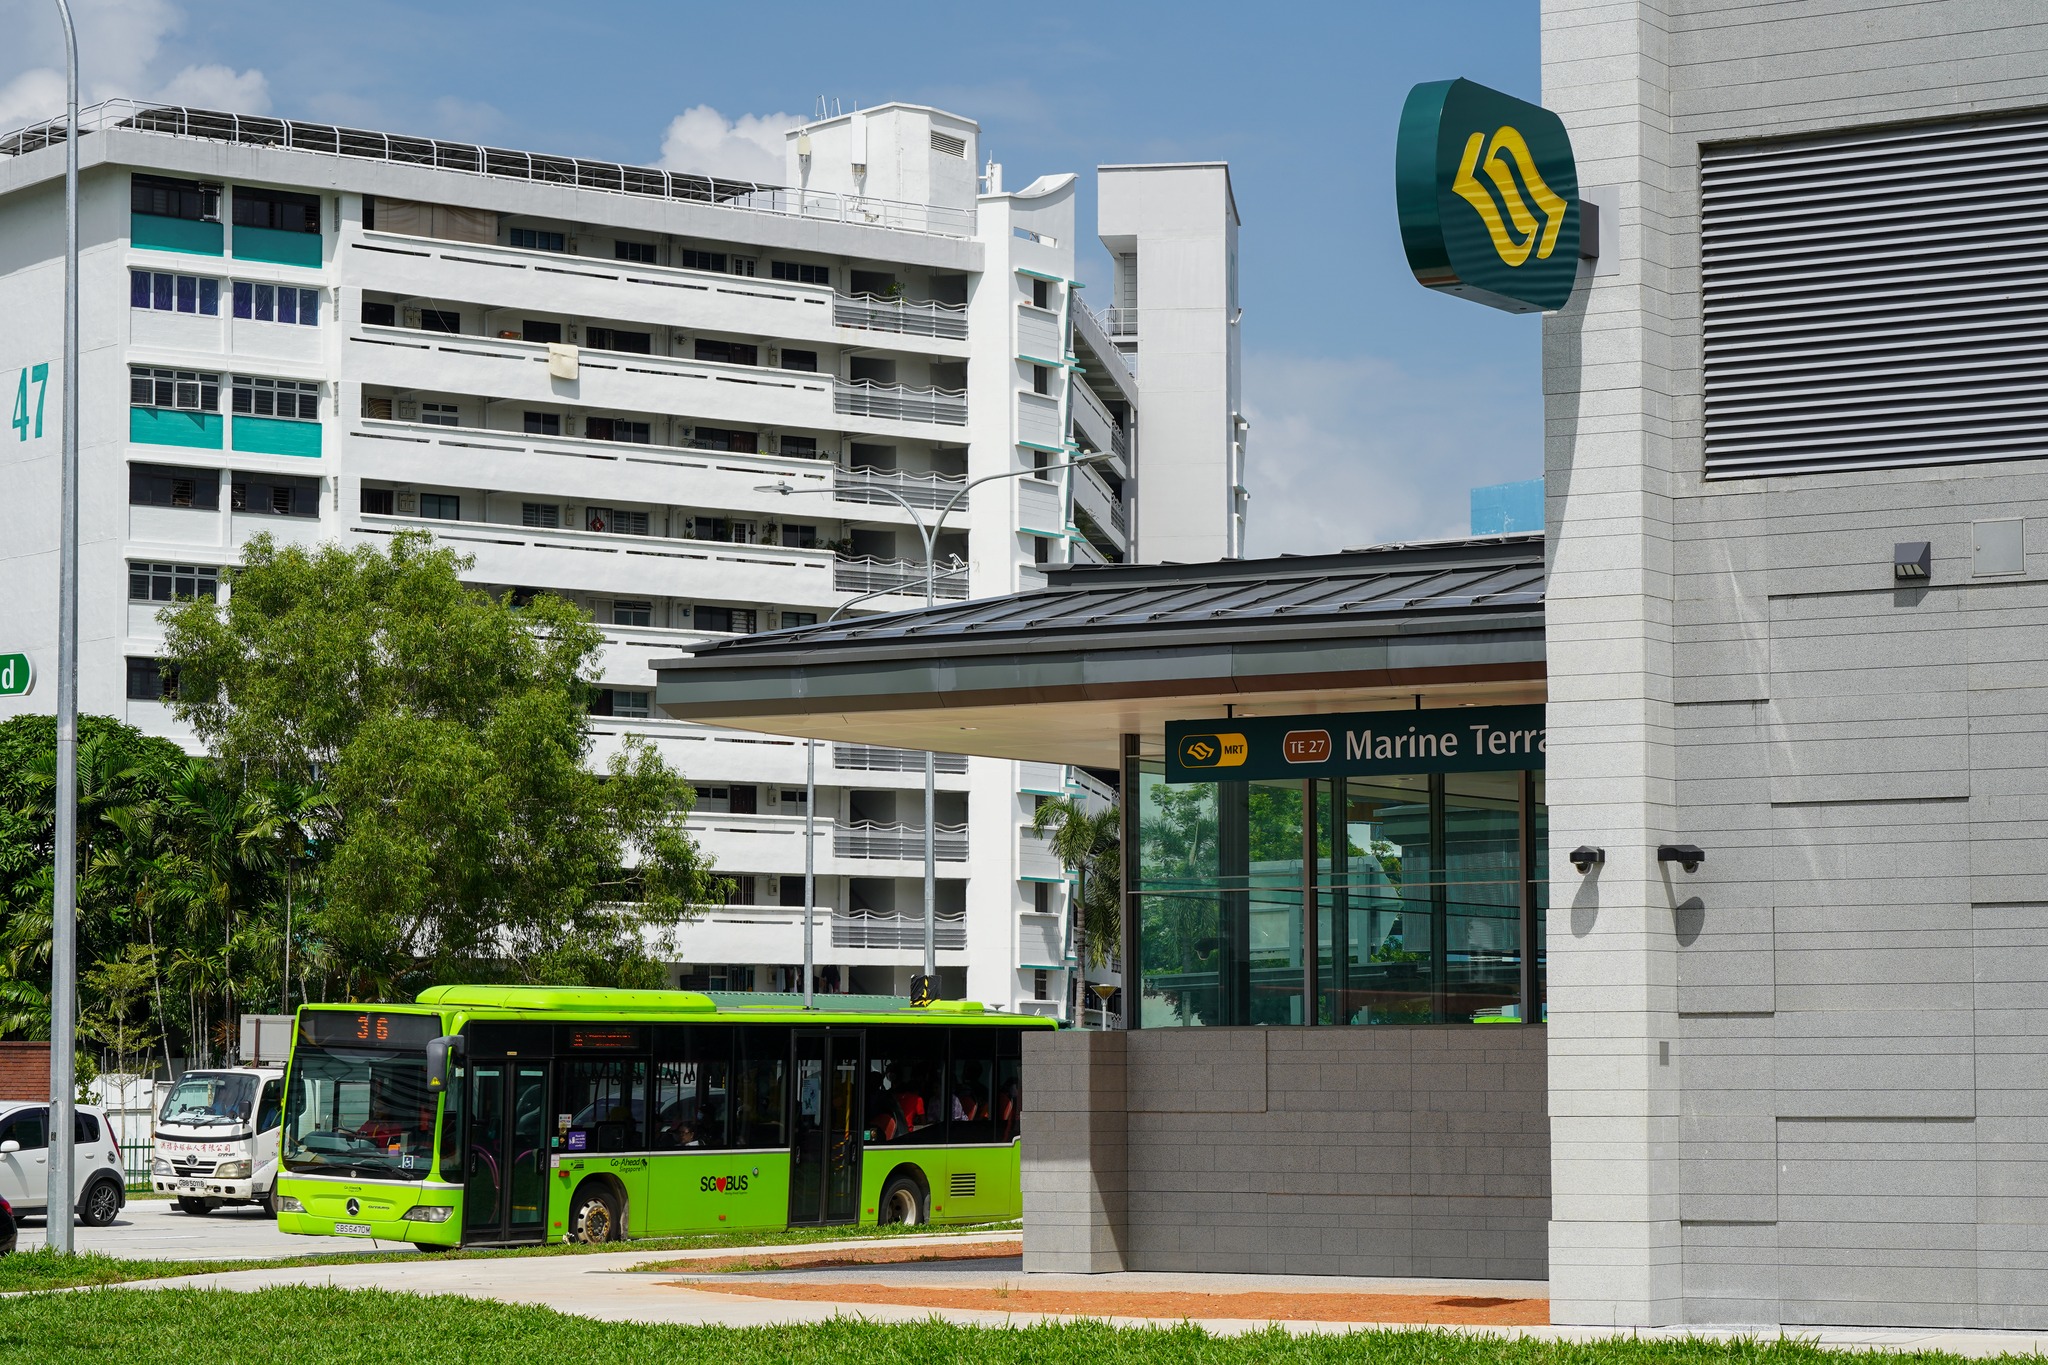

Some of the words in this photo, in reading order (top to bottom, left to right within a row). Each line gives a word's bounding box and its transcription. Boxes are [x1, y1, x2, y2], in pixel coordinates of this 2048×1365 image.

[12, 362, 49, 442] 47
[1224, 744, 1244, 755] MRT
[1289, 741, 1305, 754] TE
[1308, 740, 1325, 753] 27
[1346, 726, 1458, 760] Marine
[357, 1015, 389, 1040] 36
[610, 1158, 641, 1167] Go-Ahead
[619, 1165, 641, 1174] Singapore
[700, 1175, 716, 1192] SG
[725, 1175, 748, 1191] BUS
[335, 1224, 371, 1234] SBS6470M
